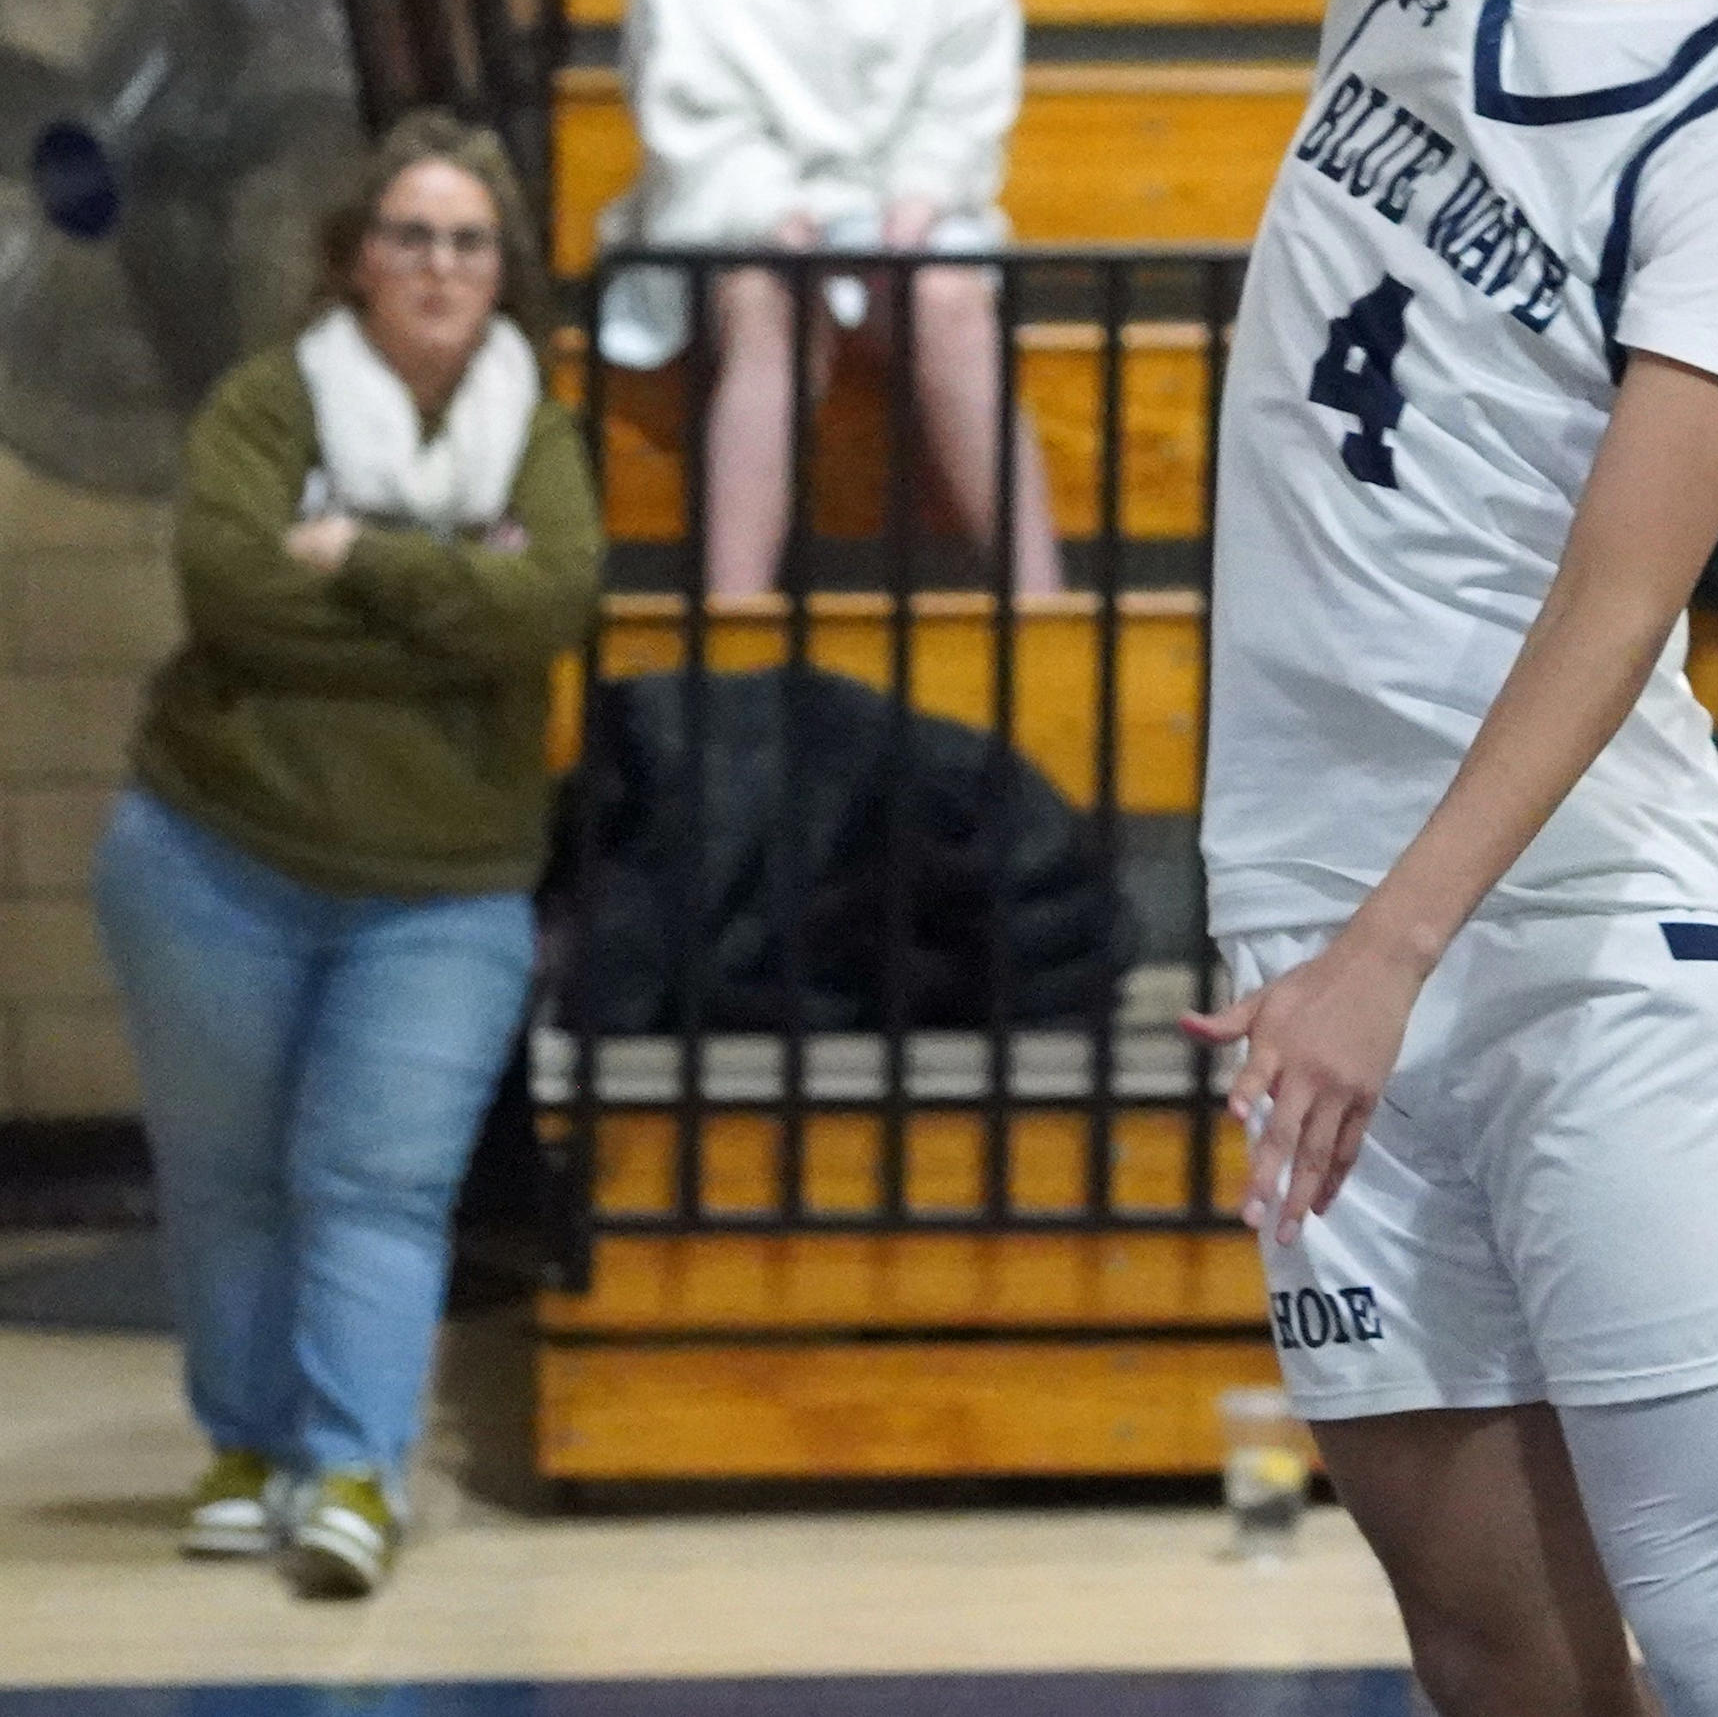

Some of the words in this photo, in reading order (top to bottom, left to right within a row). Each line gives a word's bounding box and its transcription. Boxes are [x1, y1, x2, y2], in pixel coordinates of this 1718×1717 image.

[1297, 73, 1454, 224] BLUE
[1426, 160, 1569, 334] WAVE
[1308, 272, 1415, 491] 4
